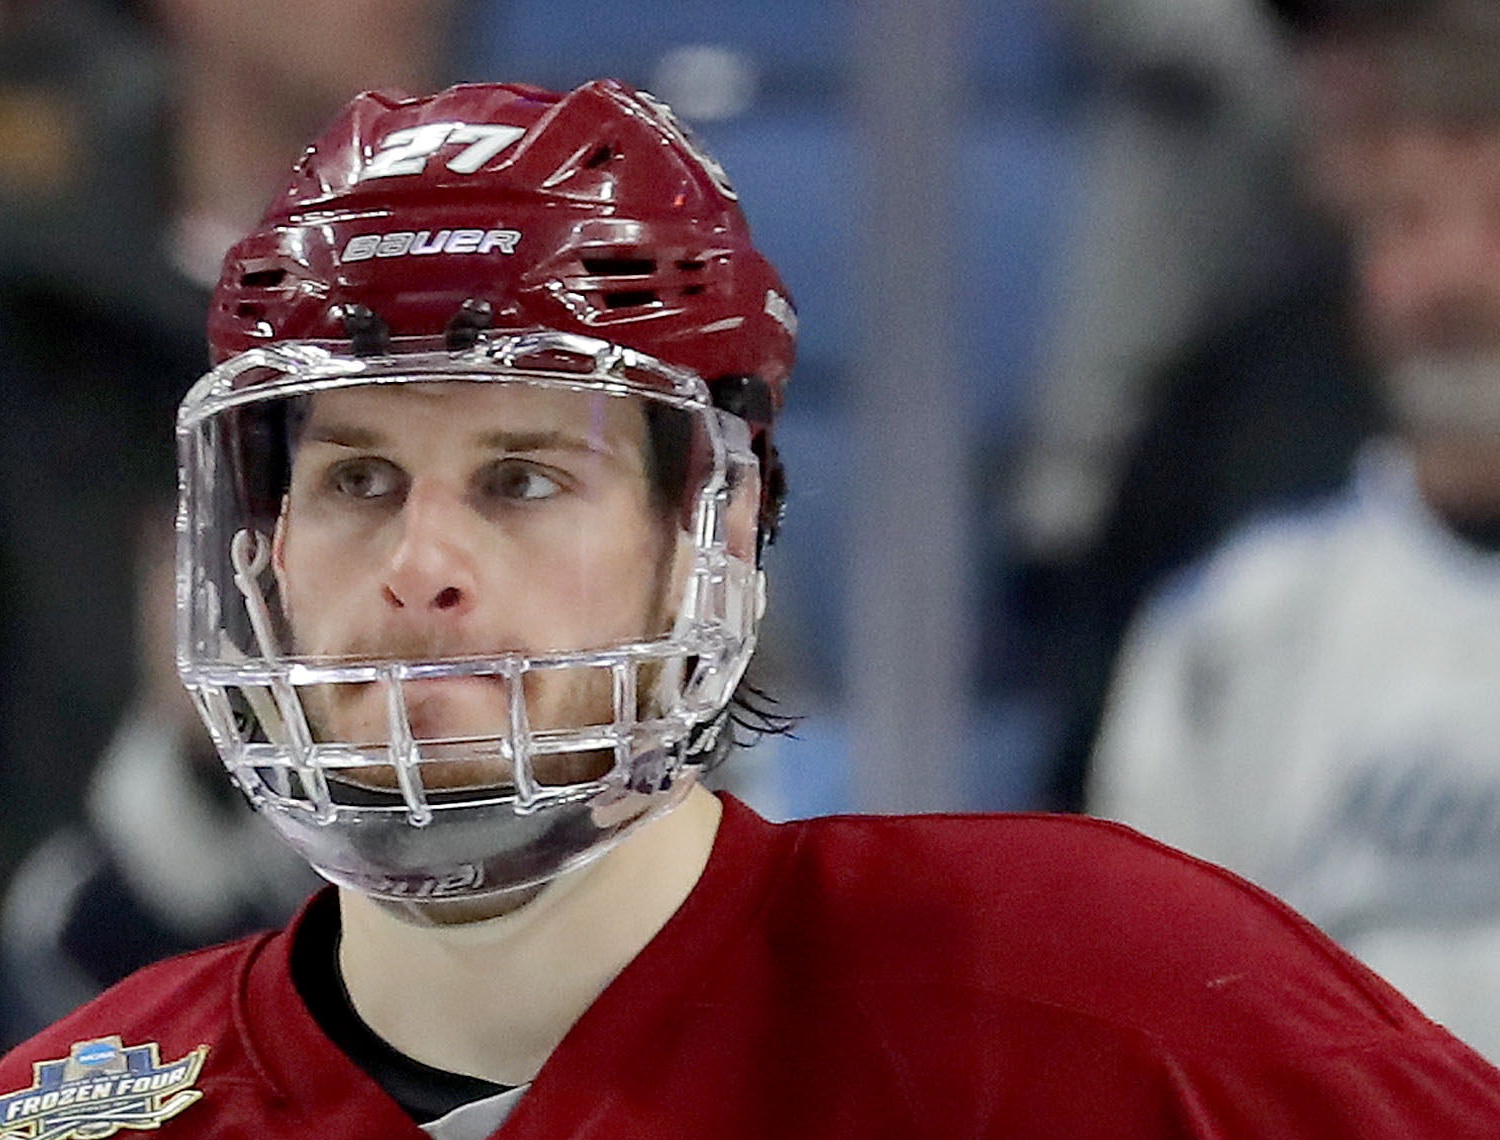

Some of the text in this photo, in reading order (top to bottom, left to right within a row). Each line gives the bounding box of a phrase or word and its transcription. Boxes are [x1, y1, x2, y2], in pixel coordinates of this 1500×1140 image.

[360, 122, 527, 180] 27
[341, 228, 523, 264] BAUER
[5, 1080, 113, 1121] FROZEN
[115, 1066, 187, 1096] FOUR
